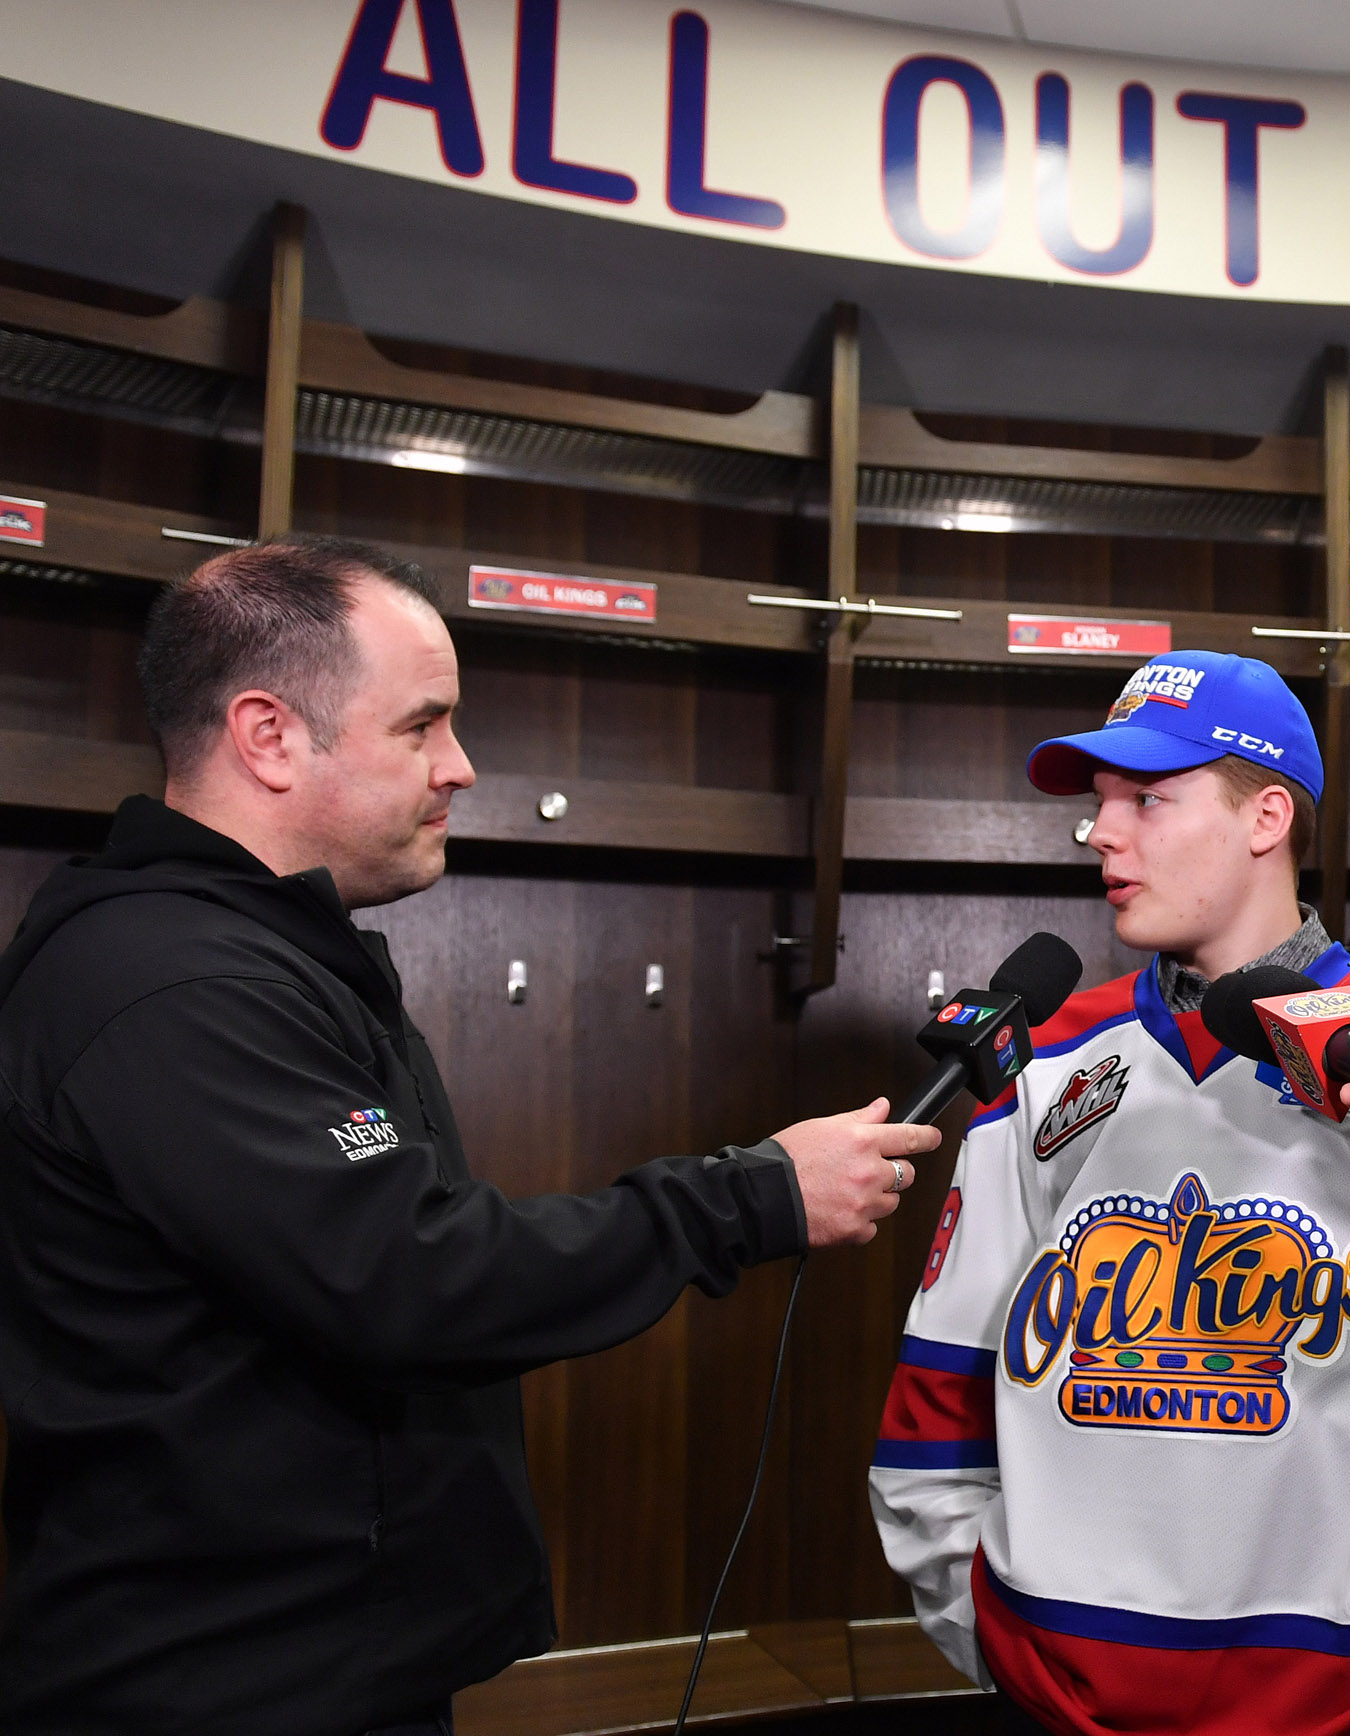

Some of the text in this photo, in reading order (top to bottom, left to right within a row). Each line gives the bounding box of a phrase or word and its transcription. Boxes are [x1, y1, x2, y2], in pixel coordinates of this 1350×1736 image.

[319, 0, 787, 231] ALL
[879, 53, 1306, 287] OUT
[522, 583, 550, 602] OIL
[553, 586, 609, 608] KINGS
[1211, 725, 1285, 760] CCM
[939, 1004, 997, 1024] CTV
[995, 1027, 1018, 1077] CTV
[351, 1107, 387, 1122] CTV
[1048, 1066, 1128, 1139] WHL
[328, 1123, 399, 1152] NEWS
[1003, 1238, 1163, 1388] Oil
[1071, 1384, 1273, 1425] EDMONTON
